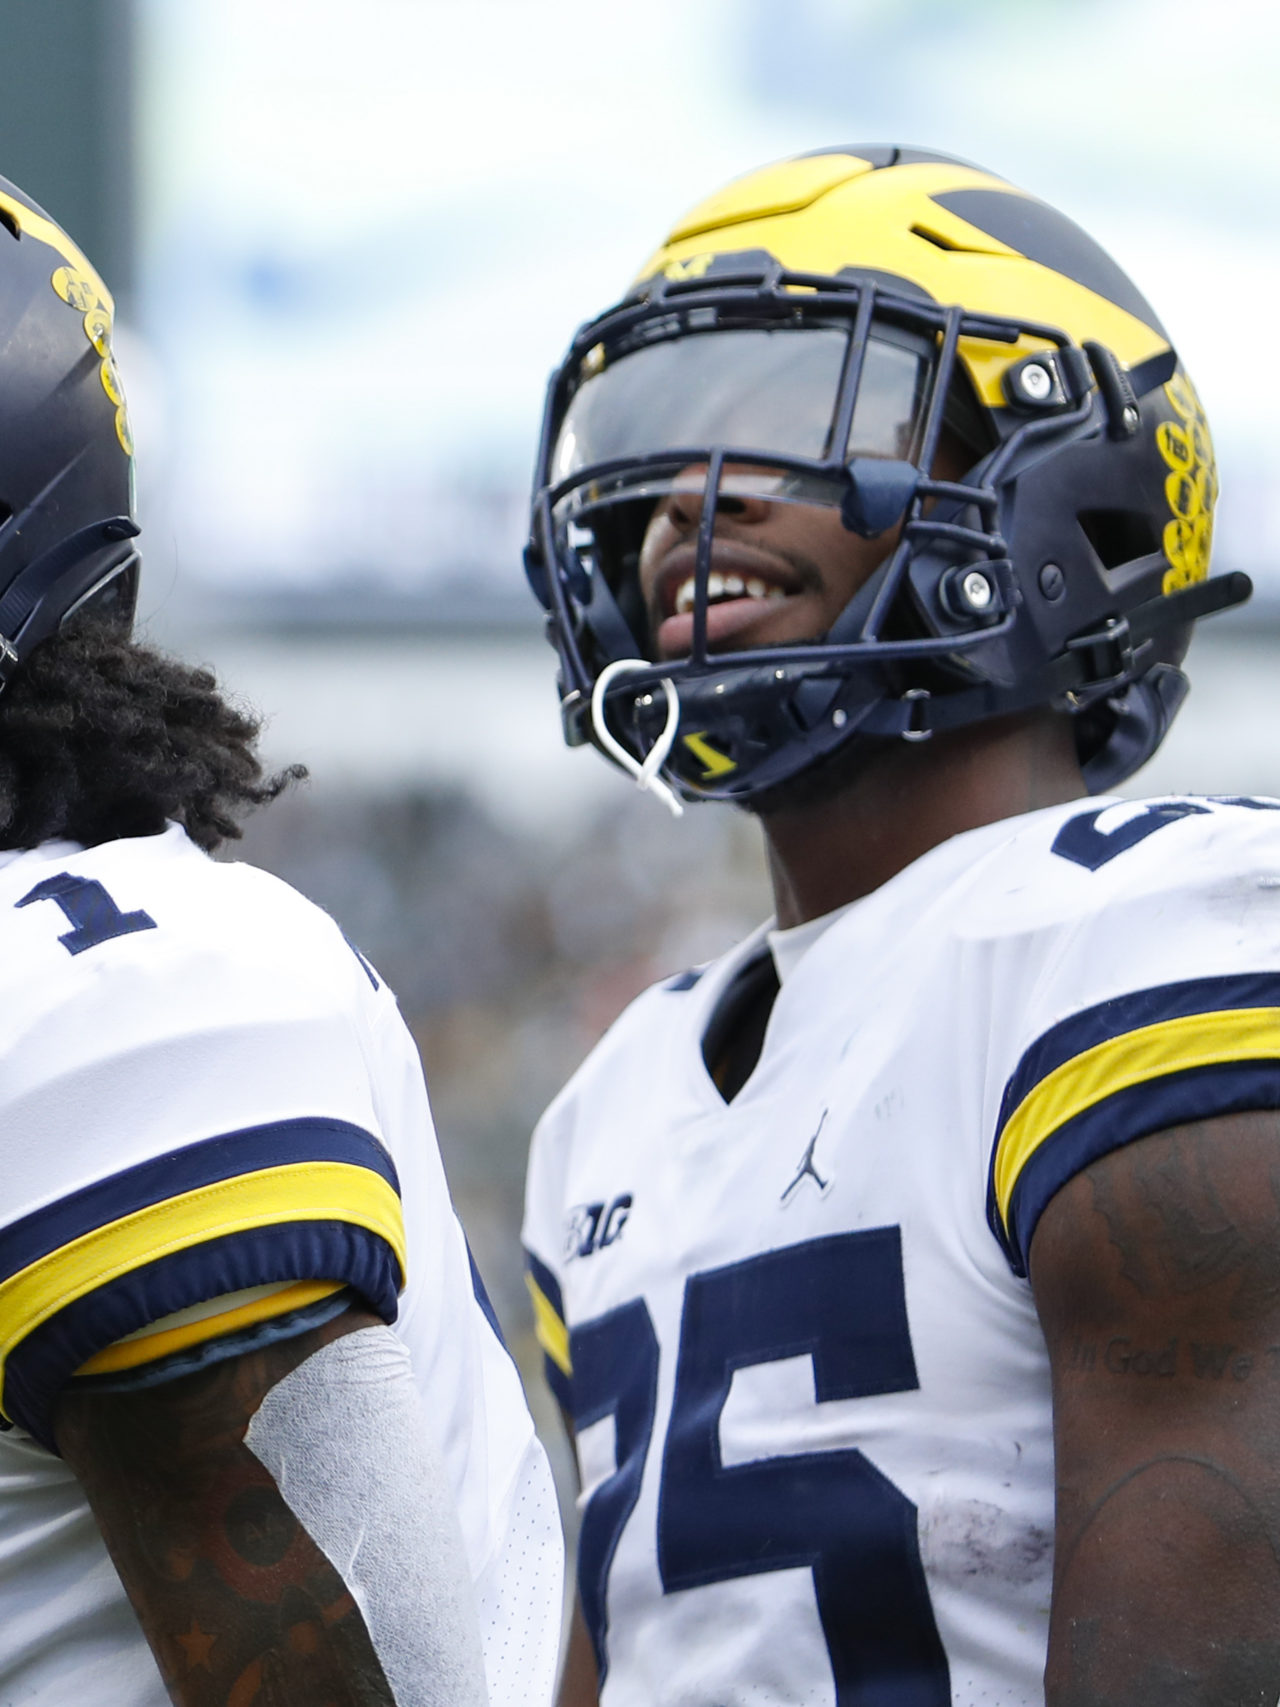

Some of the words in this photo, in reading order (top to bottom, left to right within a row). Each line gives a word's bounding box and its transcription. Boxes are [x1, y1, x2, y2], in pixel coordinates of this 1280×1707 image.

[663, 252, 714, 282] M
[14, 872, 158, 956] 1
[1104, 1336, 1180, 1379] God
